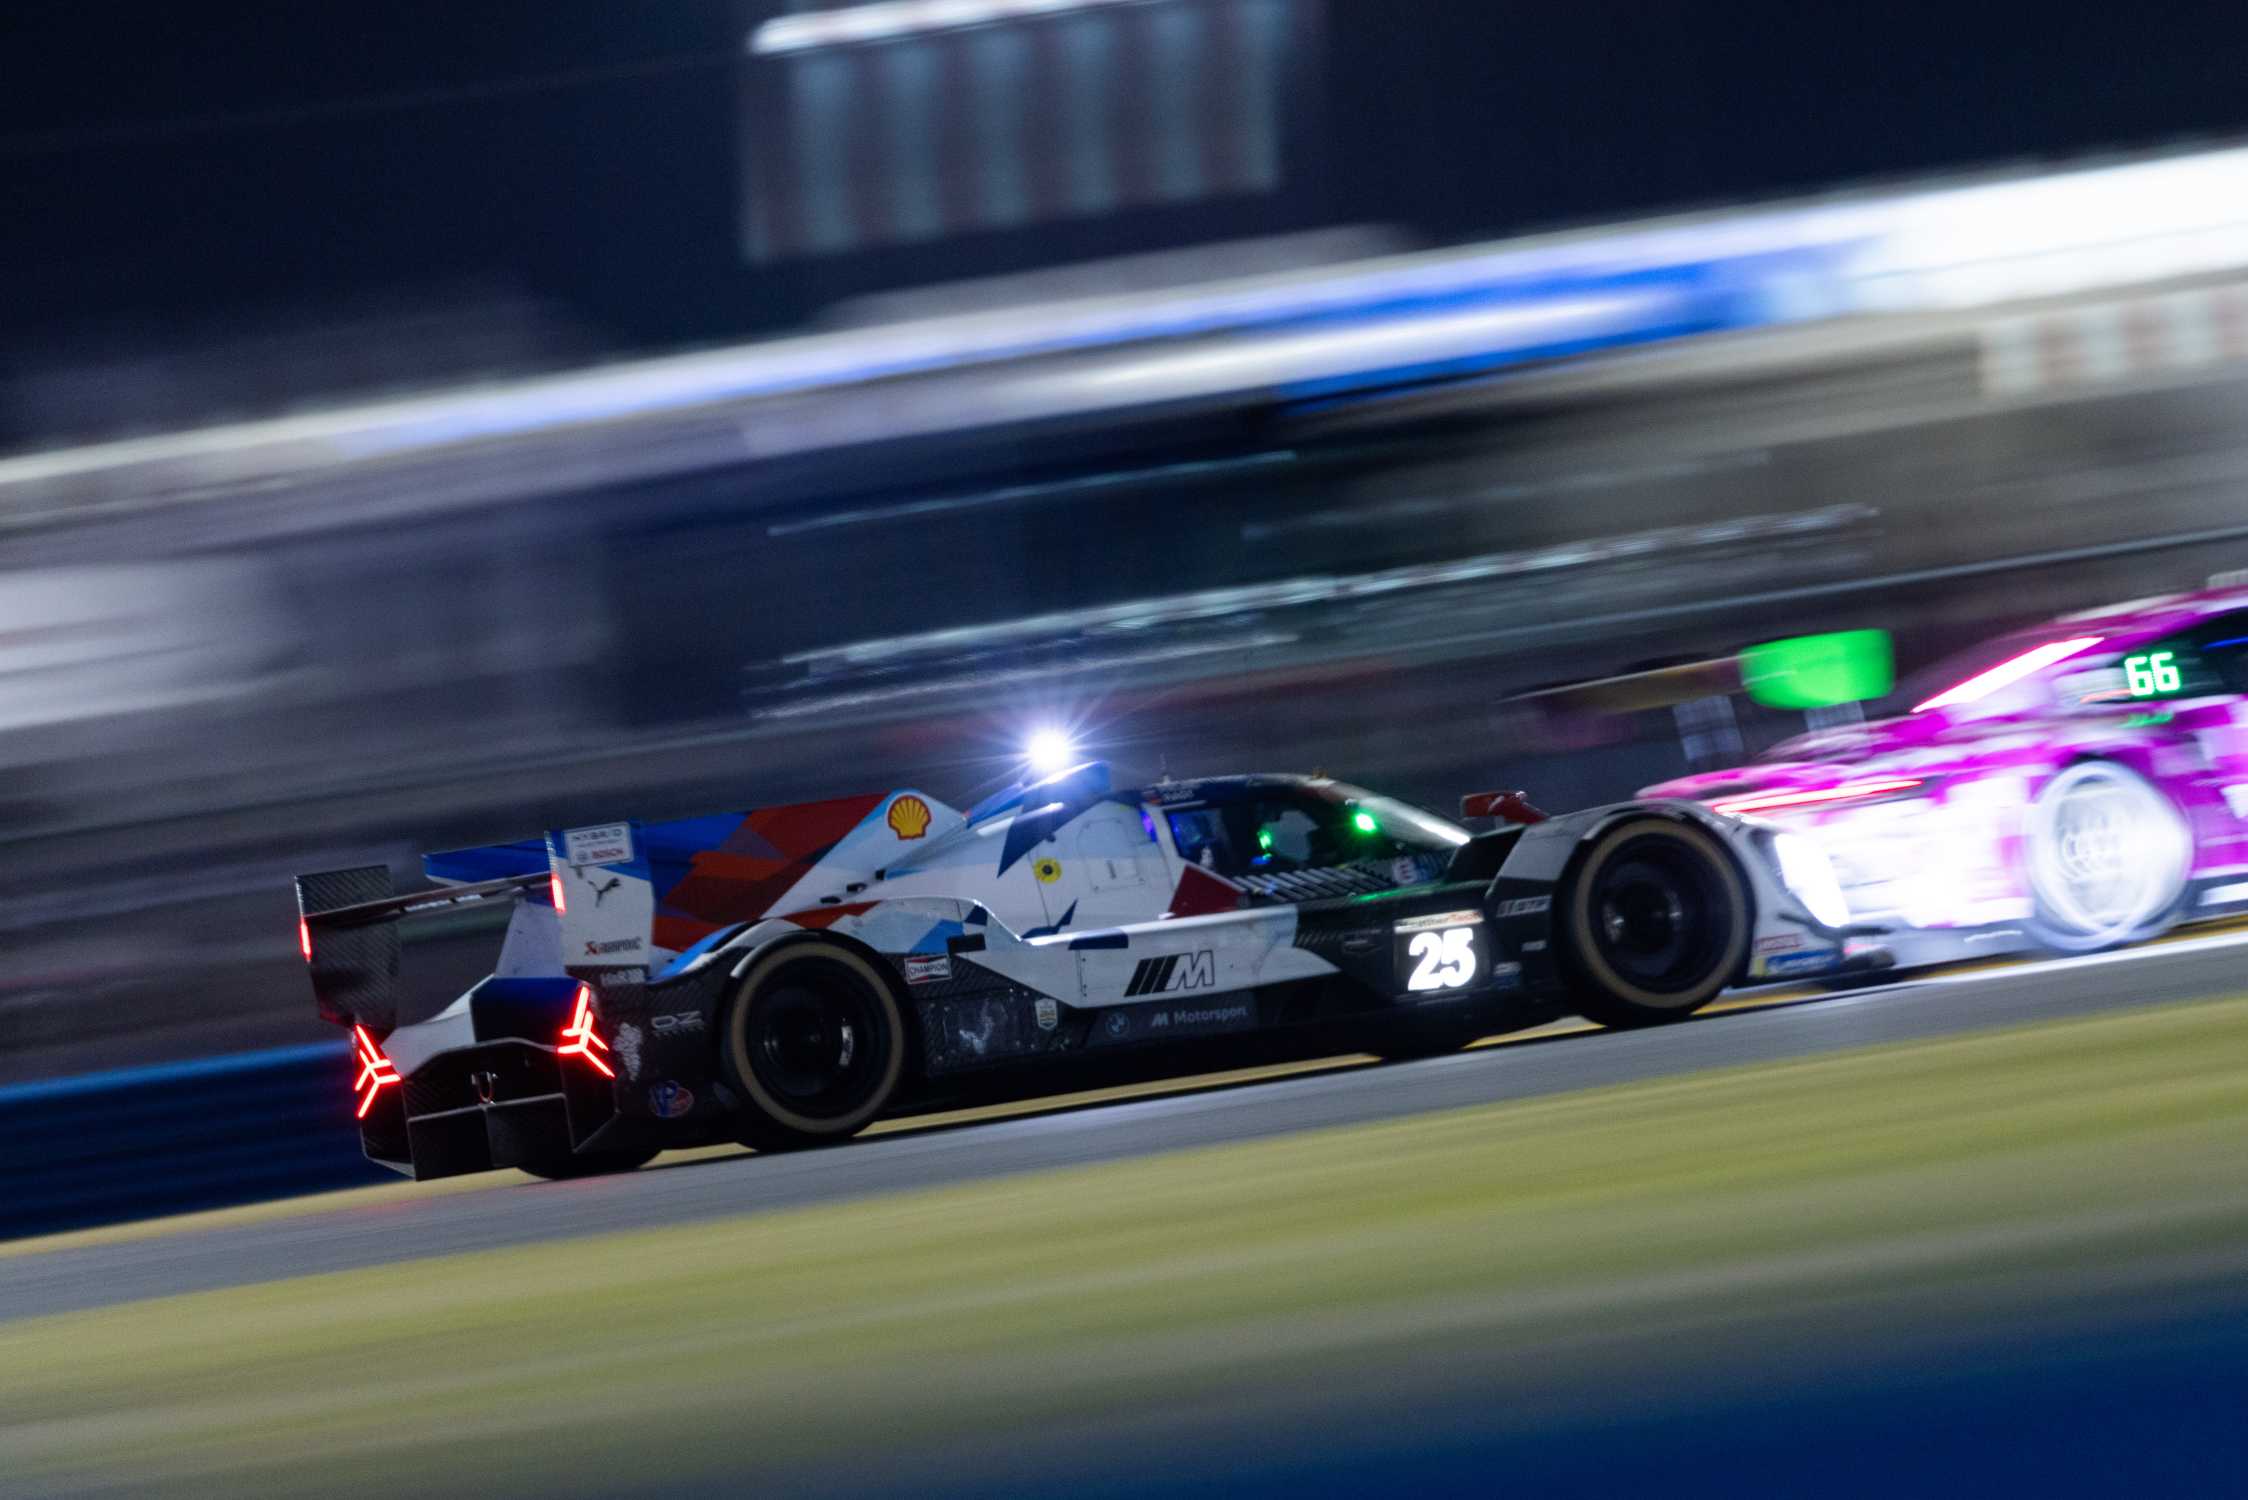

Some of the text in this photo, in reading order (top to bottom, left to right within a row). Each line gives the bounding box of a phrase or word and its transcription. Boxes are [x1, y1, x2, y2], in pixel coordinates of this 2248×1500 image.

[2123, 651, 2181, 697] 66
[1407, 927, 1477, 992] 25
[1172, 1005, 1248, 1025] Motorsport
